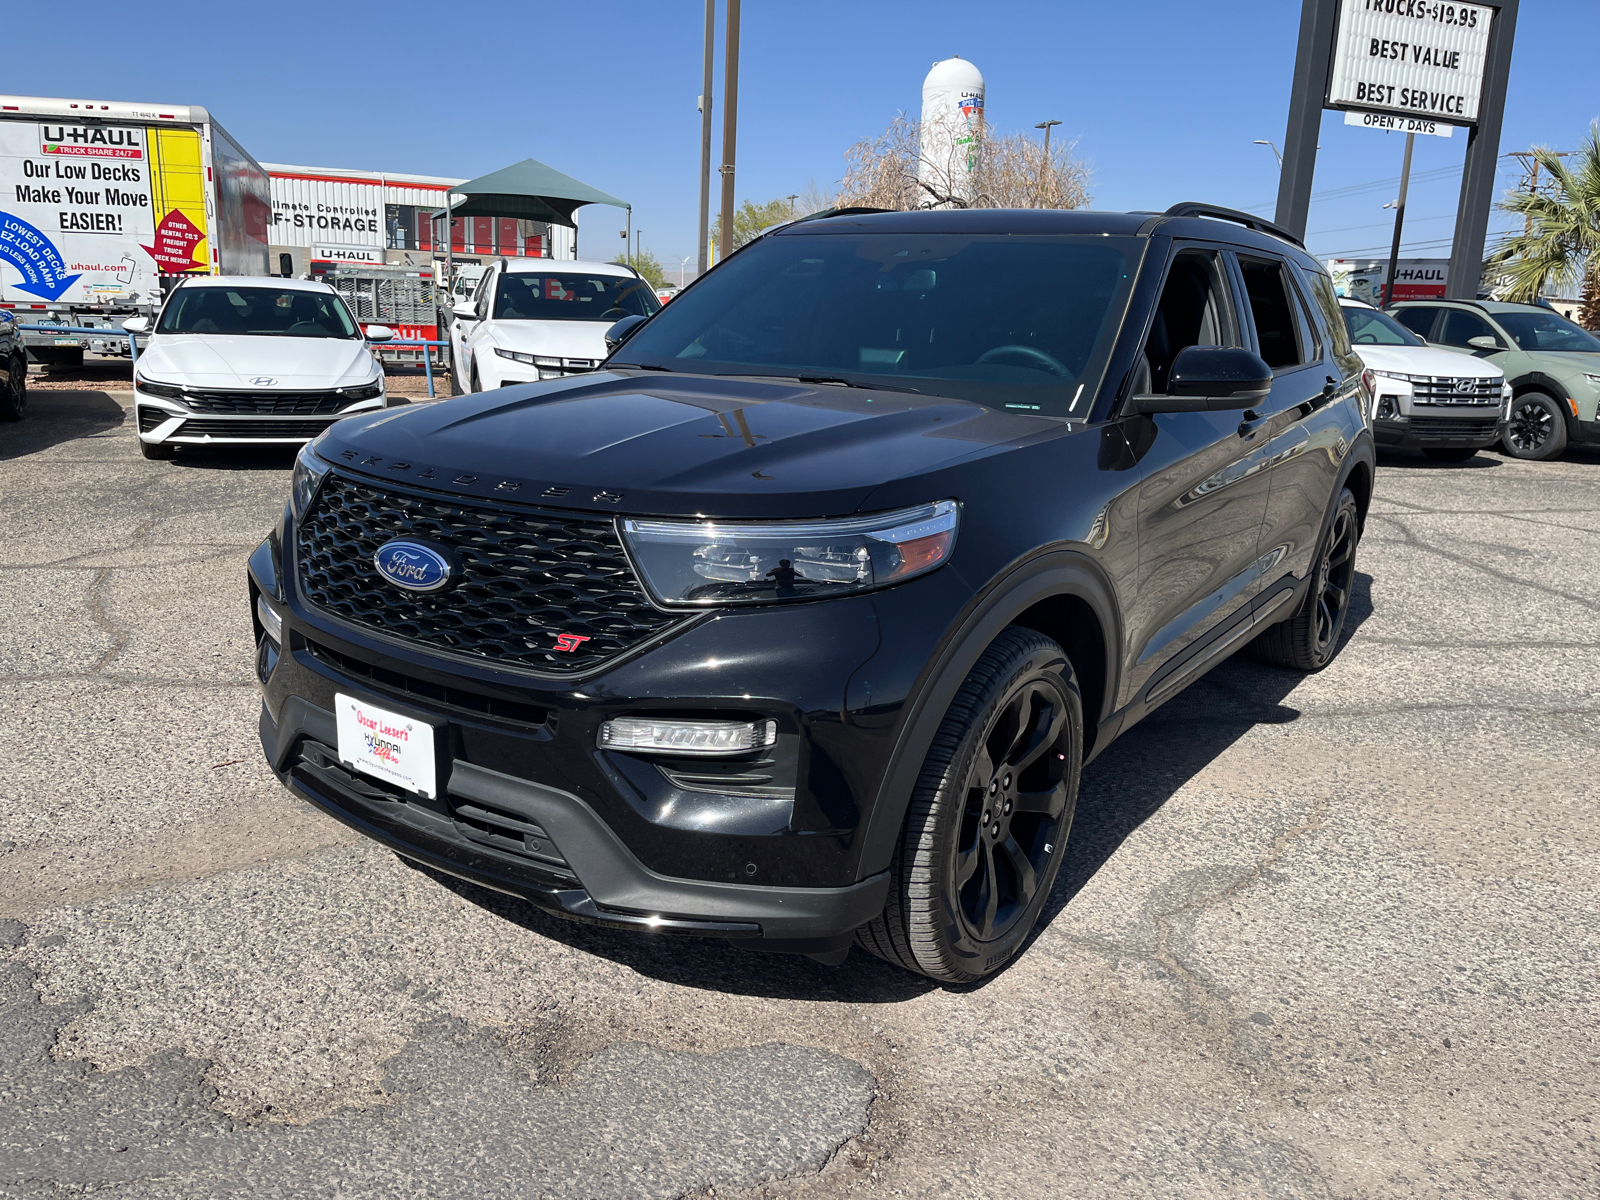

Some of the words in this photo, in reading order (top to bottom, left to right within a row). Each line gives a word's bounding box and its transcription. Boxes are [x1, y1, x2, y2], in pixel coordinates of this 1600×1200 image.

[1369, 38, 1409, 61] BEST
[1413, 45, 1460, 69] VALUE
[1356, 81, 1395, 104] BEST
[1400, 87, 1464, 114] SERVICE
[1363, 114, 1394, 129] OPEN
[1398, 119, 1405, 129] 7
[1407, 120, 1436, 133] DAYS
[44, 126, 140, 147] U-HAUL
[60, 146, 86, 155] TRUCK
[87, 147, 114, 156] SHARE
[115, 149, 132, 157] 24/7
[23, 159, 51, 178] Our
[55, 160, 87, 180] Low
[91, 162, 141, 182] Decks
[15, 184, 62, 204] Make
[65, 186, 101, 205] Your
[105, 188, 148, 207] Move
[272, 200, 309, 211] limate
[317, 203, 377, 217] Controlled
[59, 211, 123, 231] EASIER!
[168, 221, 187, 230] OTHER
[273, 212, 378, 233] F-STORAGE
[160, 229, 183, 238] RENTAL
[162, 238, 188, 247] FREIGHT
[0, 230, 40, 261] EZ-LOAD
[36, 260, 56, 289] RAMP
[4, 219, 45, 248] LOWEST
[41, 247, 67, 280] DECKS
[154, 254, 170, 262] DECK
[170, 256, 191, 265] HEIGHT
[163, 246, 183, 255] TRUCK
[321, 249, 375, 261] U-HAUL
[9, 249, 27, 265] LESS
[23, 262, 39, 284] WORK
[70, 262, 127, 272] uhaul.com
[340, 449, 625, 504] EXPLORER
[387, 550, 430, 581] Ford
[552, 633, 591, 652] ST
[356, 710, 378, 730] Oscar
[379, 720, 409, 742] Leeser's
[364, 732, 402, 755] HYUNDAI
